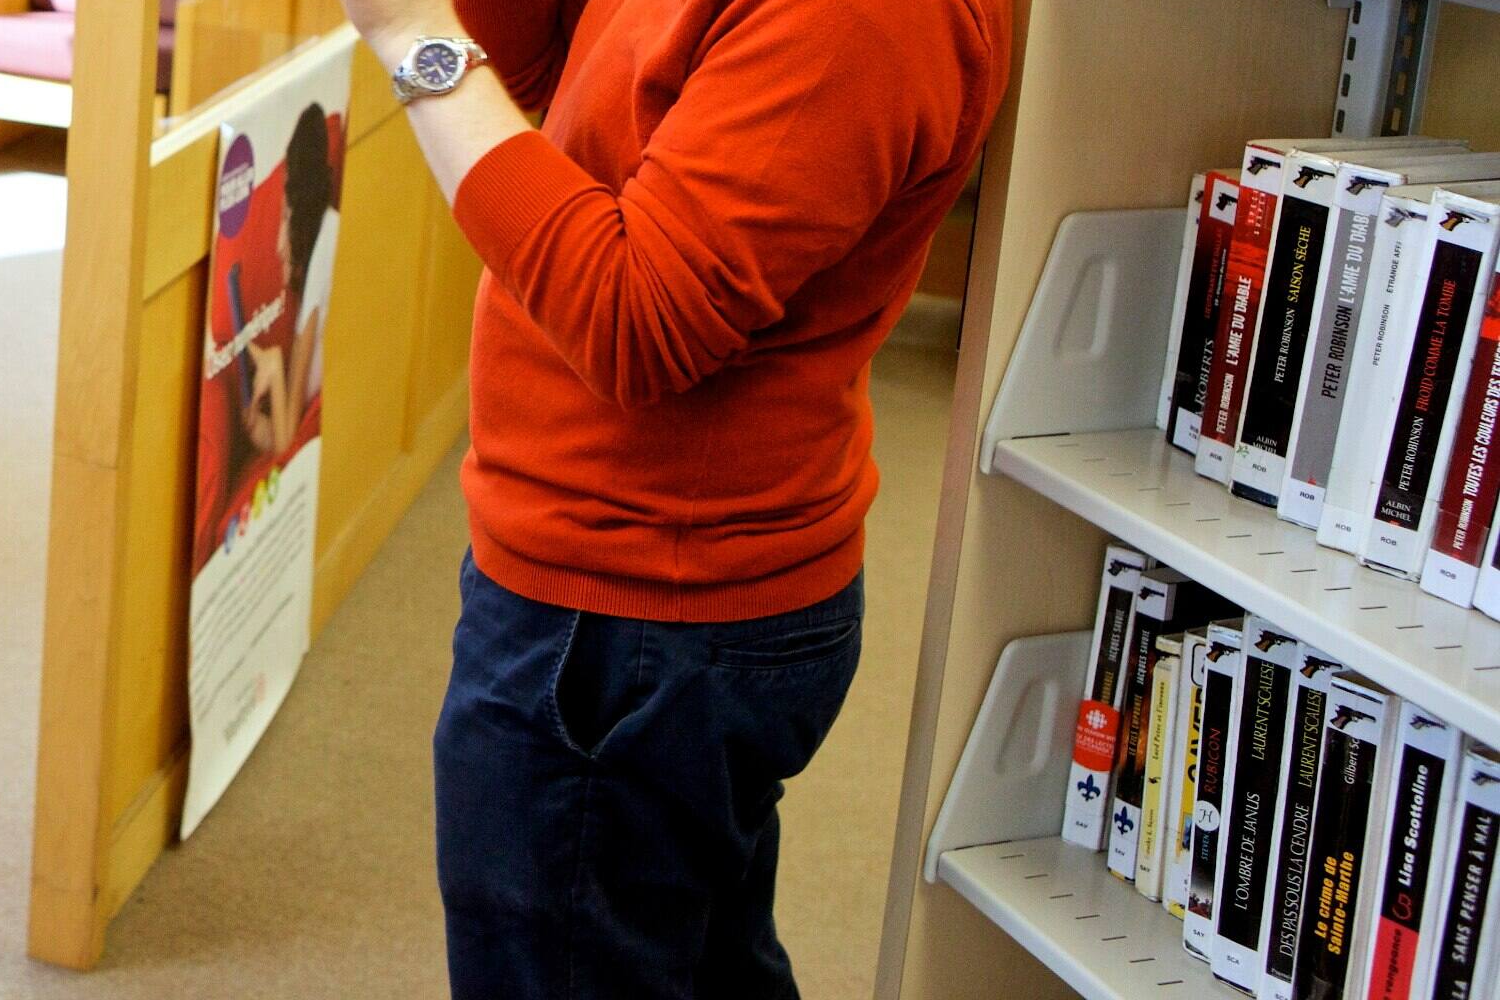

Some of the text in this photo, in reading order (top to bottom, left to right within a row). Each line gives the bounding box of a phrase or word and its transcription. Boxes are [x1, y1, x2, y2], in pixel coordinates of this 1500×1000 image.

[1346, 243, 1364, 262] DU
[1338, 264, 1360, 304] L'AMIE
[1274, 225, 1311, 383] PETER ROBINSON SAISON SÈCHE
[1329, 305, 1353, 361] ROBINSON
[1372, 342, 1382, 366] PETER
[1379, 304, 1390, 342] ROBINSON
[1216, 275, 1252, 434] PETER ROBINSON L'AMIE DU DIABLE
[1195, 338, 1214, 408] ROBERTS
[1321, 363, 1342, 398] PETER
[1398, 279, 1456, 491] PETER ROBINSON FROID COMME LA TOMBE
[1485, 378, 1500, 398] DES
[1475, 397, 1499, 445] COULEURS
[1256, 435, 1277, 447] ALBIN
[1472, 445, 1488, 465] LES
[1252, 463, 1266, 473] ROB
[1463, 462, 1483, 497] TOUTES
[1299, 491, 1315, 500] ROB
[1386, 500, 1412, 512] ALBIN
[1335, 523, 1351, 532] ROB
[1381, 507, 1412, 522] MICHEL
[1458, 499, 1474, 530] ROBINSON
[1380, 536, 1397, 546] ROB
[1452, 528, 1467, 550] PETER
[1440, 569, 1456, 580] ROB
[1108, 634, 1120, 662] JACQUES
[1140, 629, 1150, 655] SAVOIE
[1136, 655, 1147, 685] JACQUES
[1252, 706, 1270, 760] LAURENT
[1203, 728, 1221, 793] RUBICON
[1298, 732, 1317, 787] LAURENT
[1344, 751, 1359, 784] Gilbert
[1243, 792, 1260, 835] JANUS
[1290, 802, 1310, 856] CENDRE
[1397, 764, 1429, 887] Lisa Scottoline
[1241, 834, 1255, 854] DE
[1474, 816, 1492, 846] MAL
[1288, 858, 1304, 874] LA
[1468, 850, 1486, 862] À
[1234, 853, 1253, 910] L'OMBRE
[1284, 873, 1302, 910] SOUS
[1314, 856, 1337, 938] Le crime de
[1459, 864, 1483, 920] PENSER
[1328, 851, 1354, 955] Sainte-Marthe
[1193, 929, 1205, 937] SAY
[1282, 908, 1298, 932] PAS
[1280, 931, 1295, 957] DES
[1452, 923, 1471, 963] SANS
[1226, 955, 1240, 965] SCA
[1385, 928, 1402, 992] vengeance
